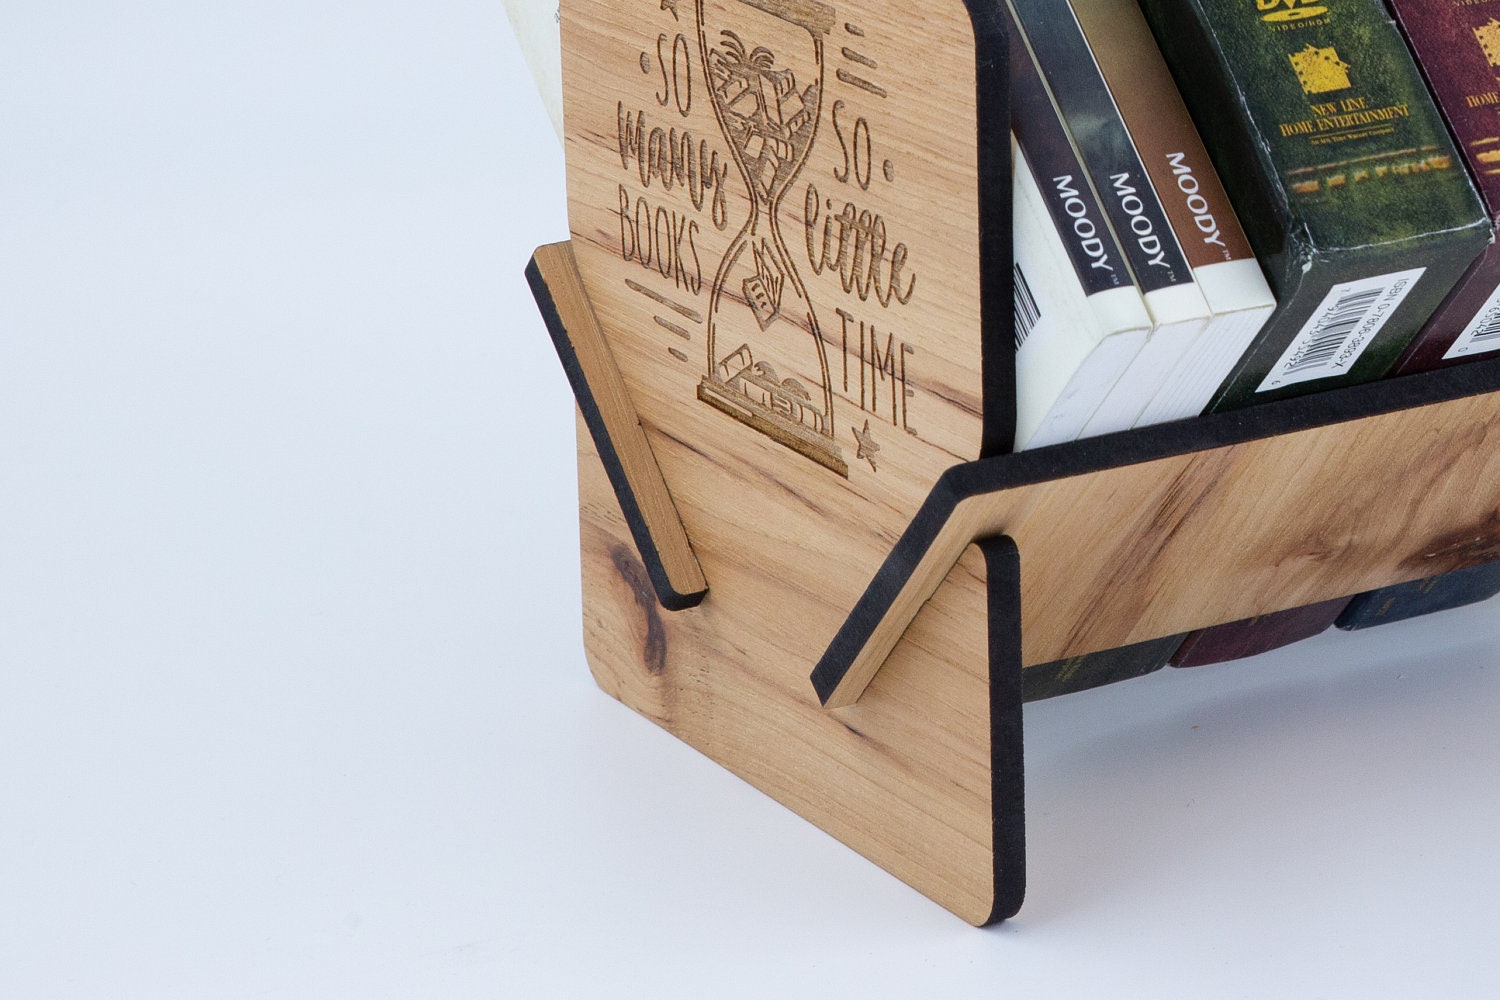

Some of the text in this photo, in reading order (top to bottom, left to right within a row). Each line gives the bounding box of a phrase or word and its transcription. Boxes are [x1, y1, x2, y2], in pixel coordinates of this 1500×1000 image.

[655, 33, 691, 117] SO
[1311, 97, 1368, 117] NEW LINE
[1279, 117, 1315, 137] HOME
[1317, 104, 1409, 131] ENTERTAINMENT
[619, 183, 702, 296] BOOKS
[805, 183, 916, 308] little
[1383, 278, 1410, 301] ISBN
[836, 307, 917, 436] TIME
